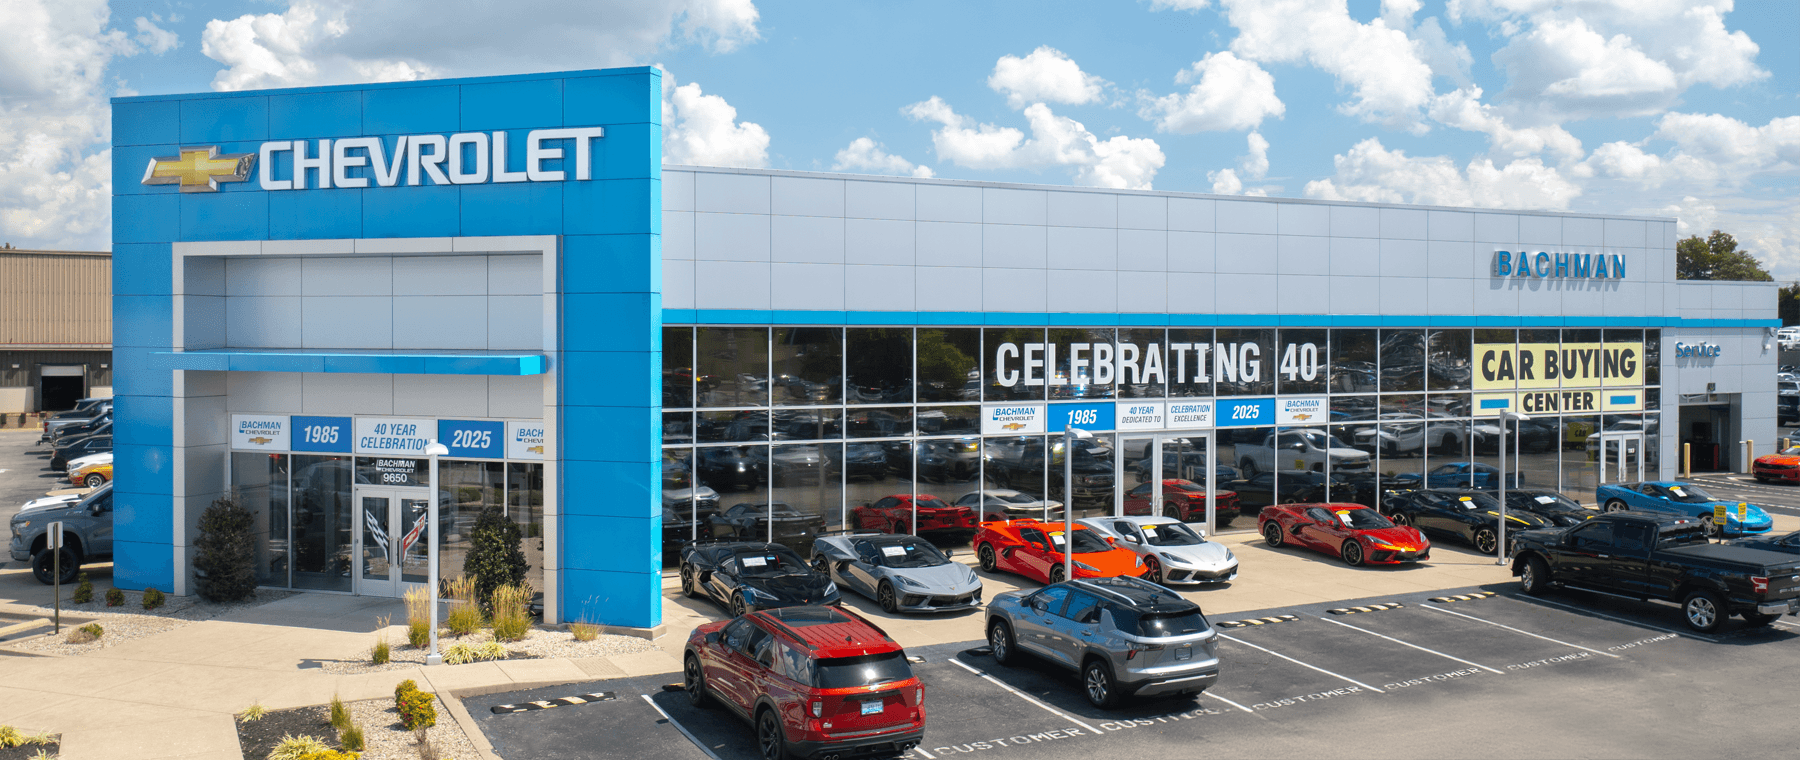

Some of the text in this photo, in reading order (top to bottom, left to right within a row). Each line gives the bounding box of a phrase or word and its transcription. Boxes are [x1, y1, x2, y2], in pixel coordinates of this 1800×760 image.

[259, 126, 605, 191] CHEVROLET
[1497, 250, 1626, 279] BACHMAN
[1675, 341, 1721, 358] Service
[996, 342, 1318, 387] CELEBRATING 40
[1481, 348, 1637, 382] CAR BUYING
[1170, 404, 1211, 414] CELEBRATION
[1287, 400, 1320, 408] BACHMAN
[1522, 392, 1594, 412] CENTER
[995, 407, 1036, 416] BACHMAN
[1067, 409, 1098, 425] 1985
[1129, 406, 1155, 415] 40 YEAR
[1173, 414, 1208, 423] EXCELLENCE
[1232, 405, 1260, 420] 2025
[241, 420, 282, 430] BACHMAN
[1121, 415, 1162, 424] DEDICATED TO
[303, 425, 340, 444] 1985
[374, 423, 417, 436] 40 YEAR
[519, 428, 544, 438] BACH
[451, 429, 492, 449] 2025
[378, 460, 415, 468] BACHMAN
[383, 473, 407, 482] 9650
[1608, 632, 1679, 653] CUSTOMER
[1506, 650, 1592, 672] CUSTOMER
[1383, 667, 1483, 691] CUSTOMER
[1252, 684, 1364, 711] CUSTOMER
[934, 726, 1087, 756] CUSTOMER
